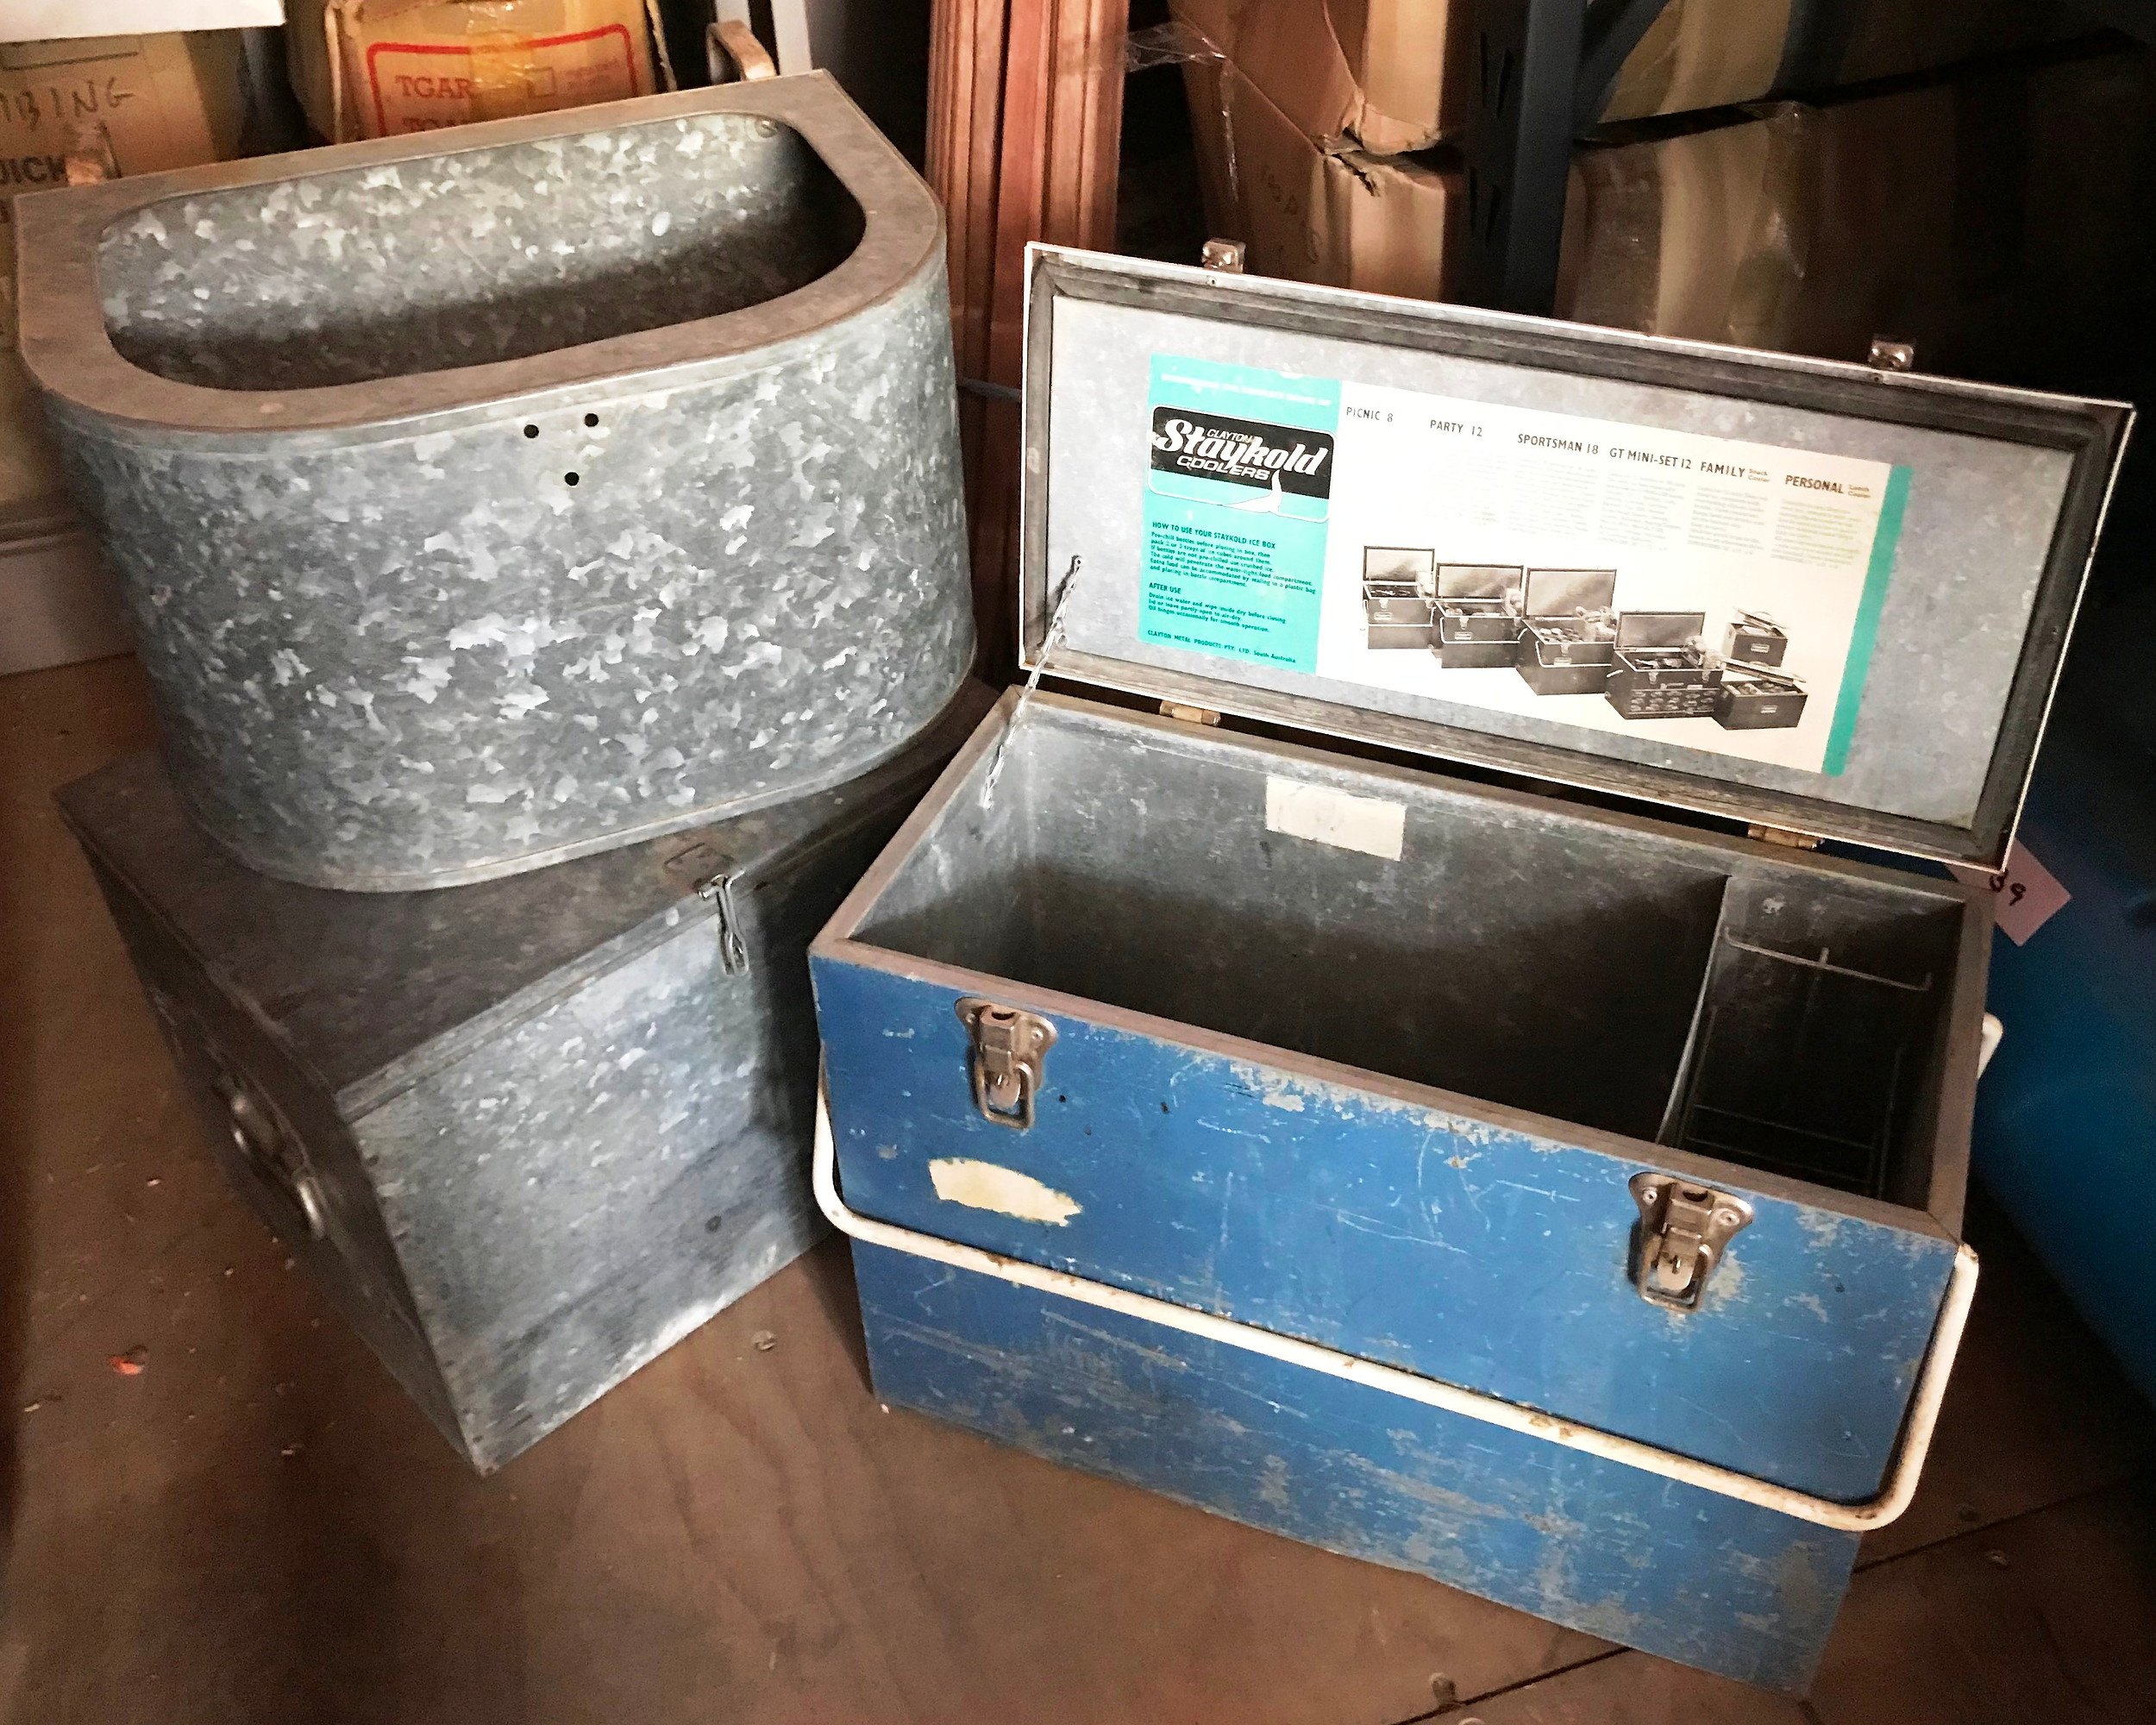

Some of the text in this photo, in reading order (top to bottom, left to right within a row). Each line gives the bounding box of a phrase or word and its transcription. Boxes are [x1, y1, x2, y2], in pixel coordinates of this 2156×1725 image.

[1346, 406, 1395, 423] PICNIC 8
[1206, 428, 1256, 443] CLAYTON
[1430, 419, 1483, 437] PARTY 12
[1148, 418, 1329, 475] Staykold
[1517, 433, 1599, 455] SPORTSMAN 18
[1176, 455, 1271, 480] COOLERS
[1609, 448, 1692, 469] GT MINI-SET 12
[1701, 461, 1745, 478] FAMILY
[1785, 474, 1844, 494] PERSONAL
[1153, 521, 1169, 530] HOW
[1194, 529, 1213, 537] YOUR
[1213, 532, 1247, 543] STAYKOLD
